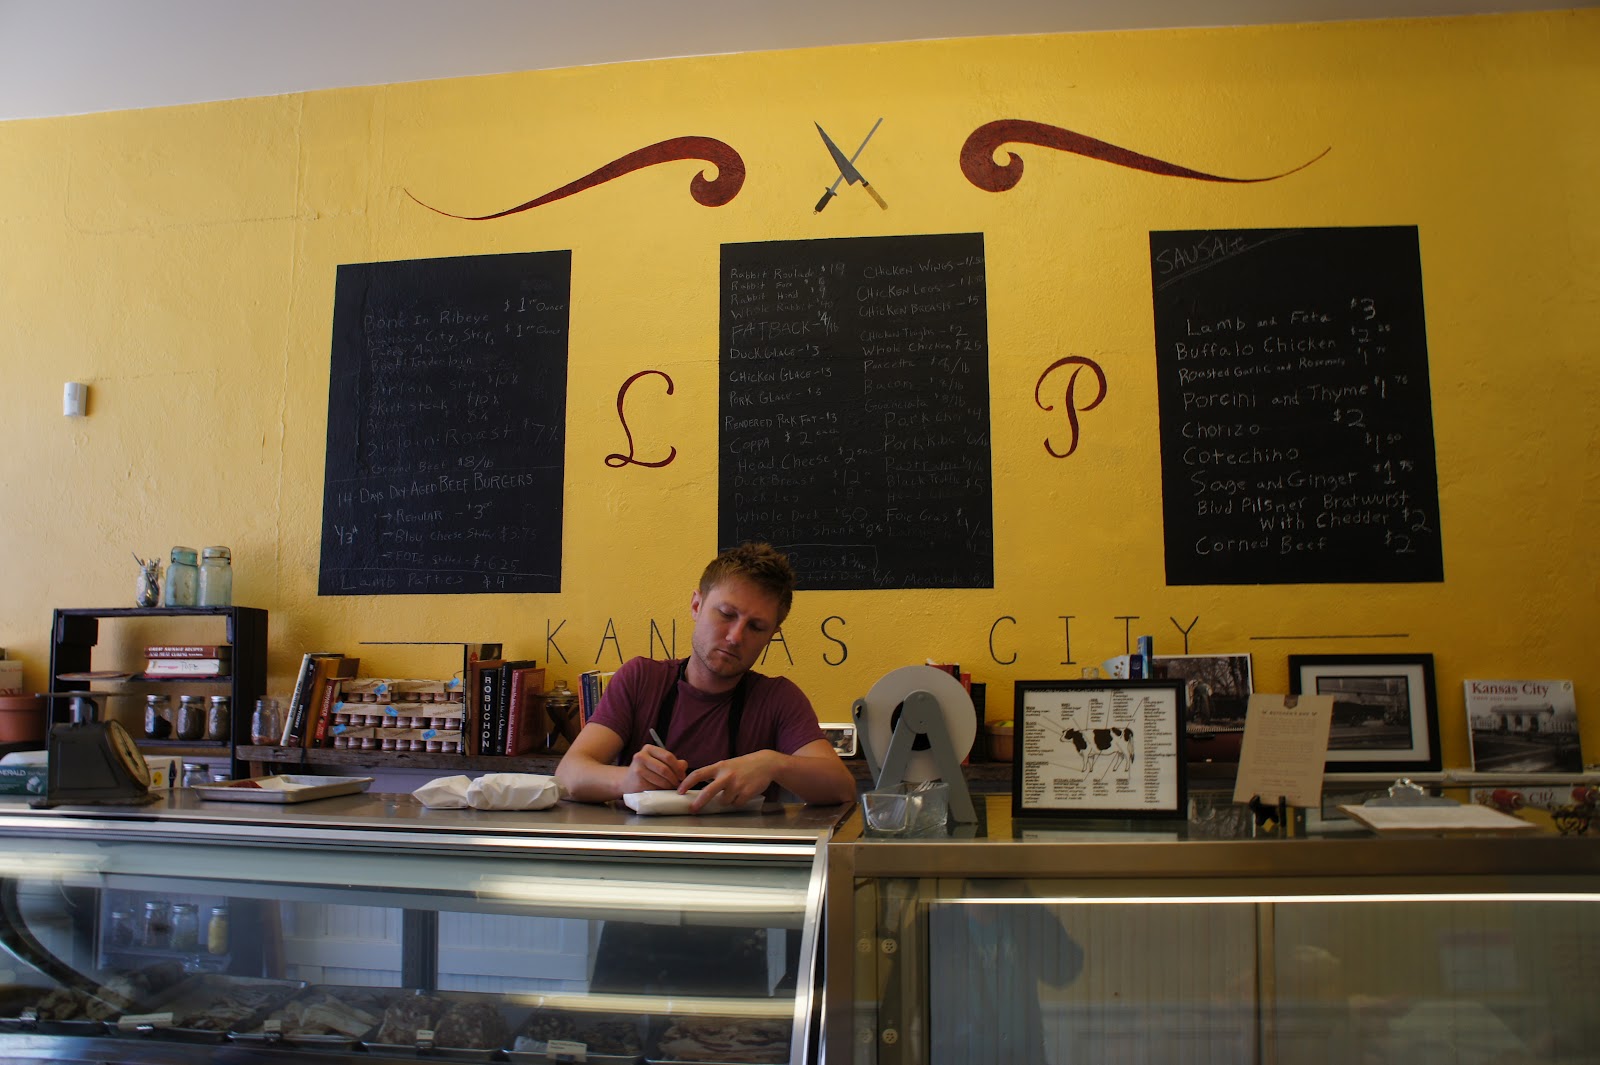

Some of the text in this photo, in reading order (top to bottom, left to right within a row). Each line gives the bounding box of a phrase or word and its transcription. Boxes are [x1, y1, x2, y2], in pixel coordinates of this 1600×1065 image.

[731, 268, 767, 279] Rabbit
[731, 281, 765, 290] Rabbit
[731, 292, 765, 305] Rabbit
[440, 311, 488, 325] Ribeye
[1187, 311, 1333, 336] Lamb and Feta
[1176, 342, 1254, 361] Buffalo
[1264, 336, 1336, 352] Chicken
[1179, 368, 1230, 386] Roasted
[1183, 392, 1256, 411] Porcini
[1272, 393, 1299, 406] and
[1307, 383, 1368, 403] Thyme
[605, 355, 1107, 468] L P
[446, 424, 509, 444] Roast
[1182, 422, 1260, 439] Chorizo
[782, 453, 830, 469] Cheese
[1183, 447, 1298, 465] Cotechino
[439, 475, 468, 493] BEEF
[474, 472, 533, 491] BURGERS
[1191, 470, 1246, 496] Sage
[1257, 474, 1282, 489] and
[1287, 471, 1357, 491] Ginger
[1242, 497, 1307, 513] Pilsner
[1323, 491, 1410, 509] Bratwurst
[736, 509, 782, 522] Whole
[1261, 517, 1304, 531] With
[1196, 536, 1268, 555] Corned
[1281, 535, 1327, 553] Beef
[546, 615, 1199, 666] KANAS CITY
[1472, 682, 1549, 698] Kansas City
[482, 676, 492, 748] ROBUCHON
